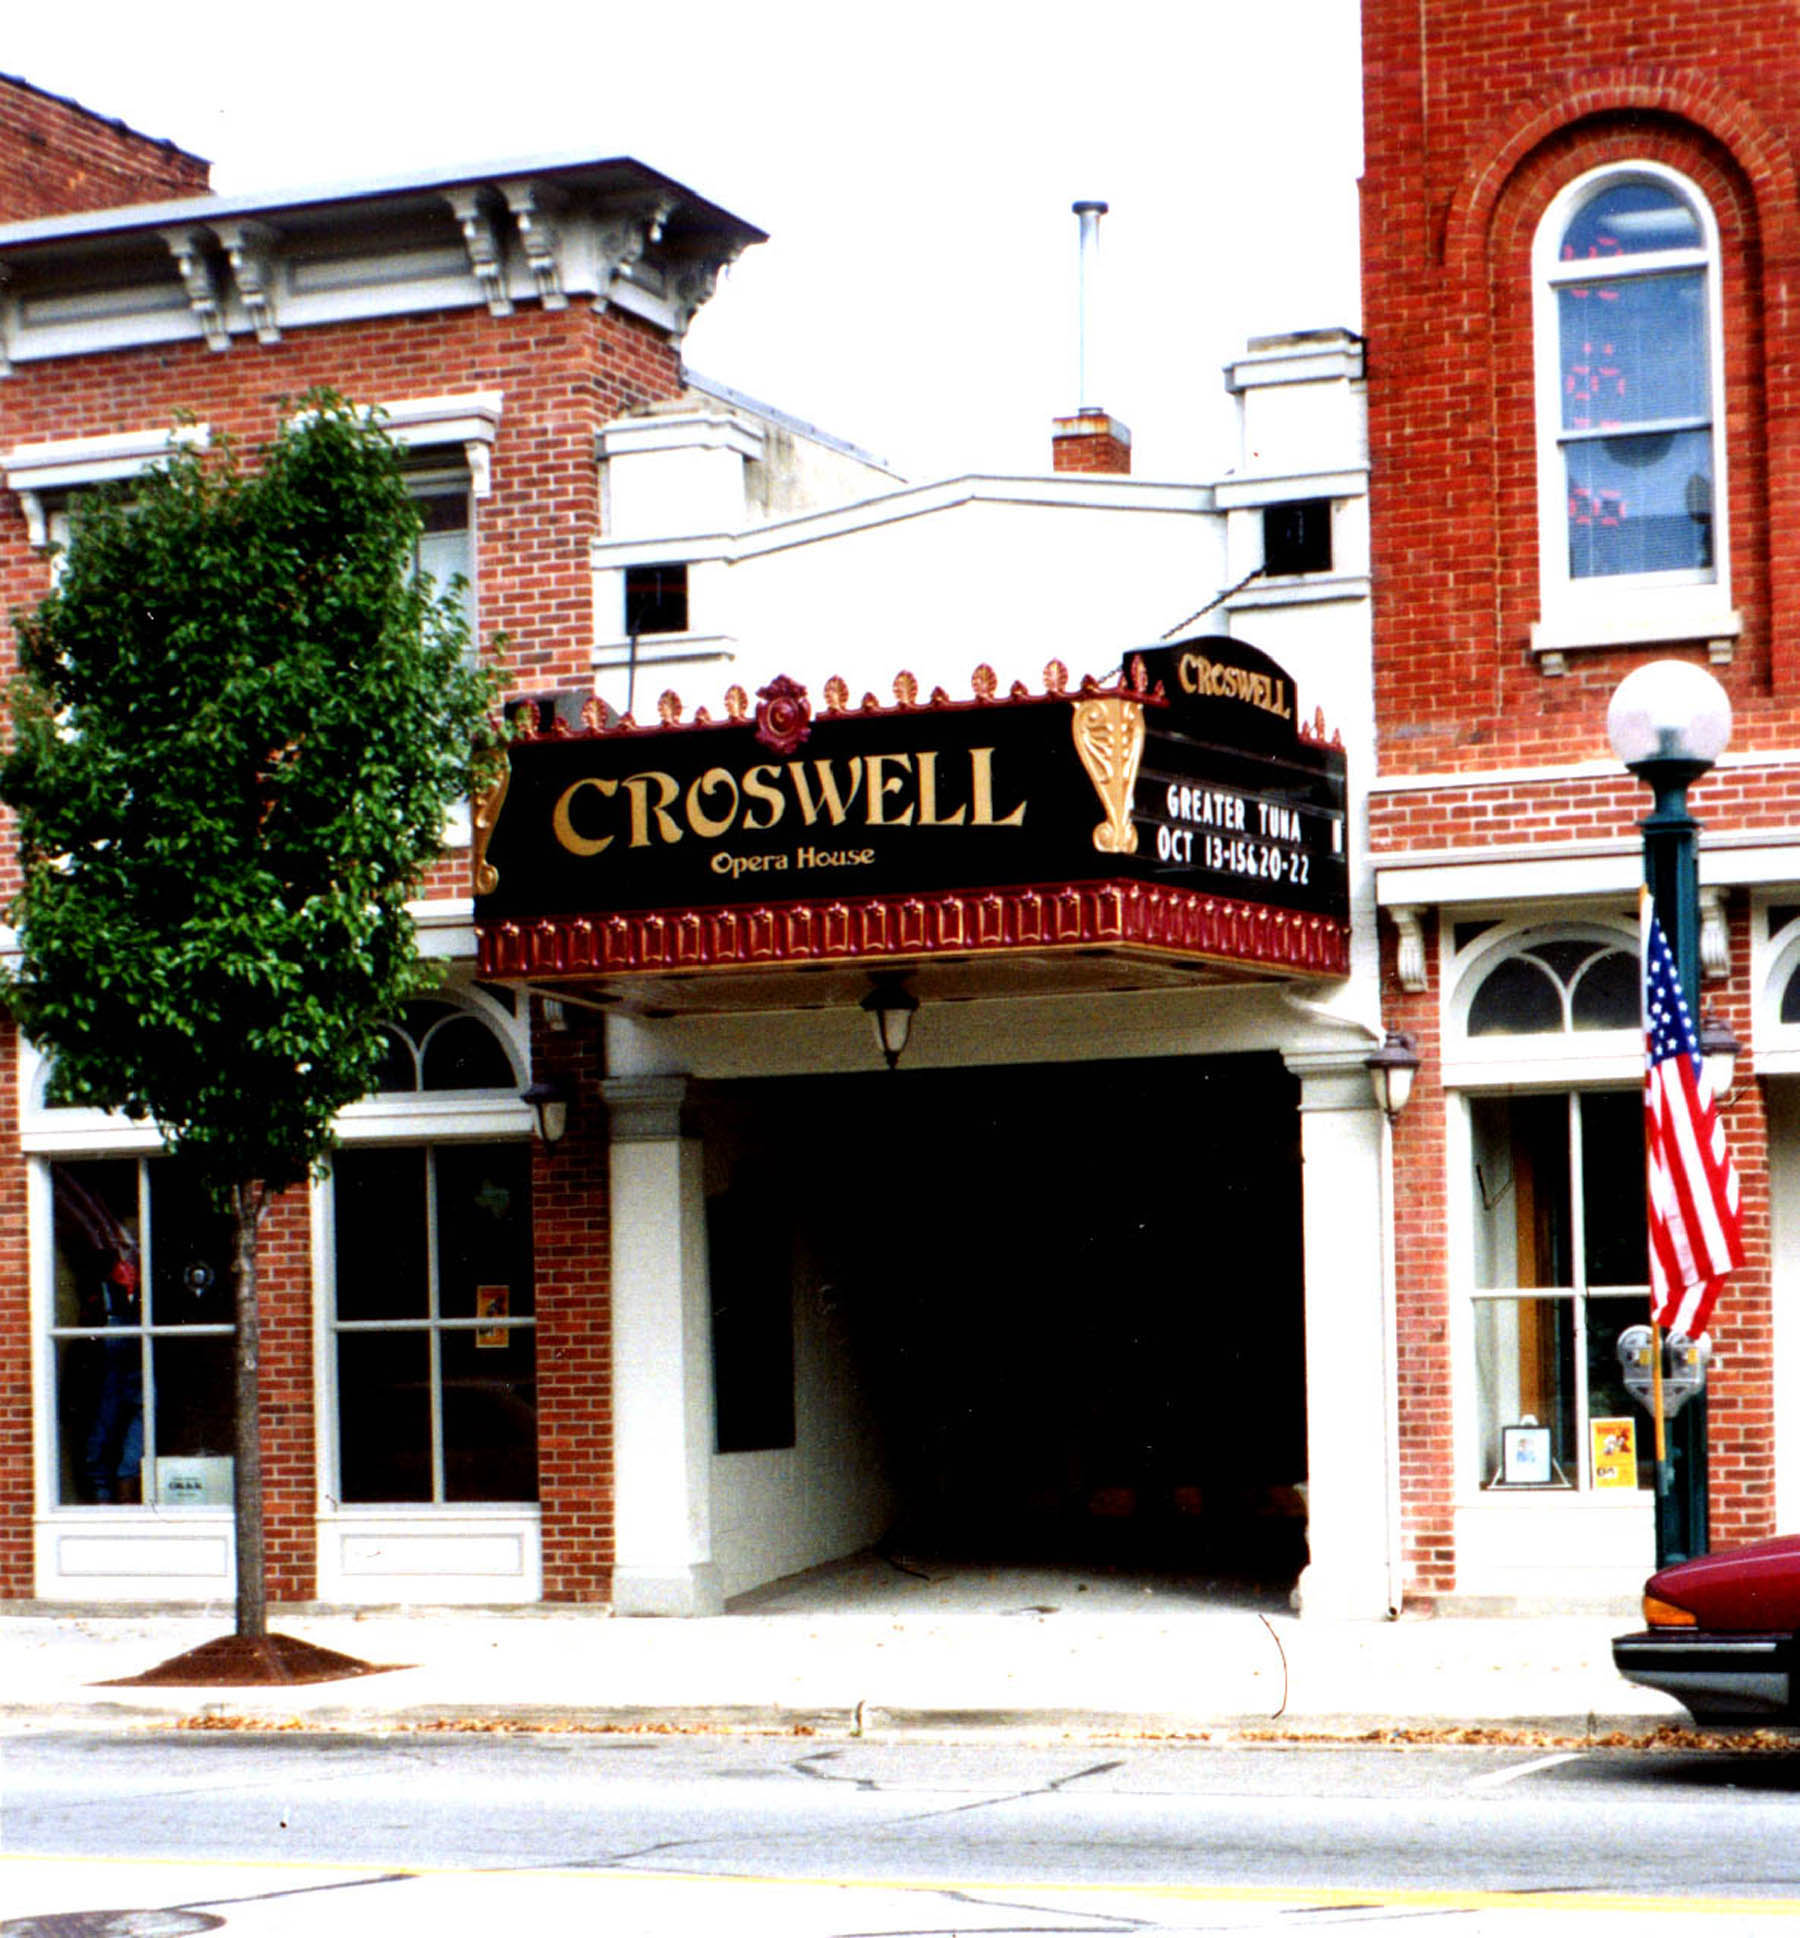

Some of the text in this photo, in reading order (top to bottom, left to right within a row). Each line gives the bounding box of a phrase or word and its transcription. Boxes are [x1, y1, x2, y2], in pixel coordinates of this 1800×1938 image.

[1179, 653, 1291, 720] CROSWELL
[553, 747, 1027, 856] CROSWELL
[1167, 784, 1301, 843] GREATER TUNA
[711, 847, 876, 878] Opera House
[1157, 825, 1193, 863] OCT
